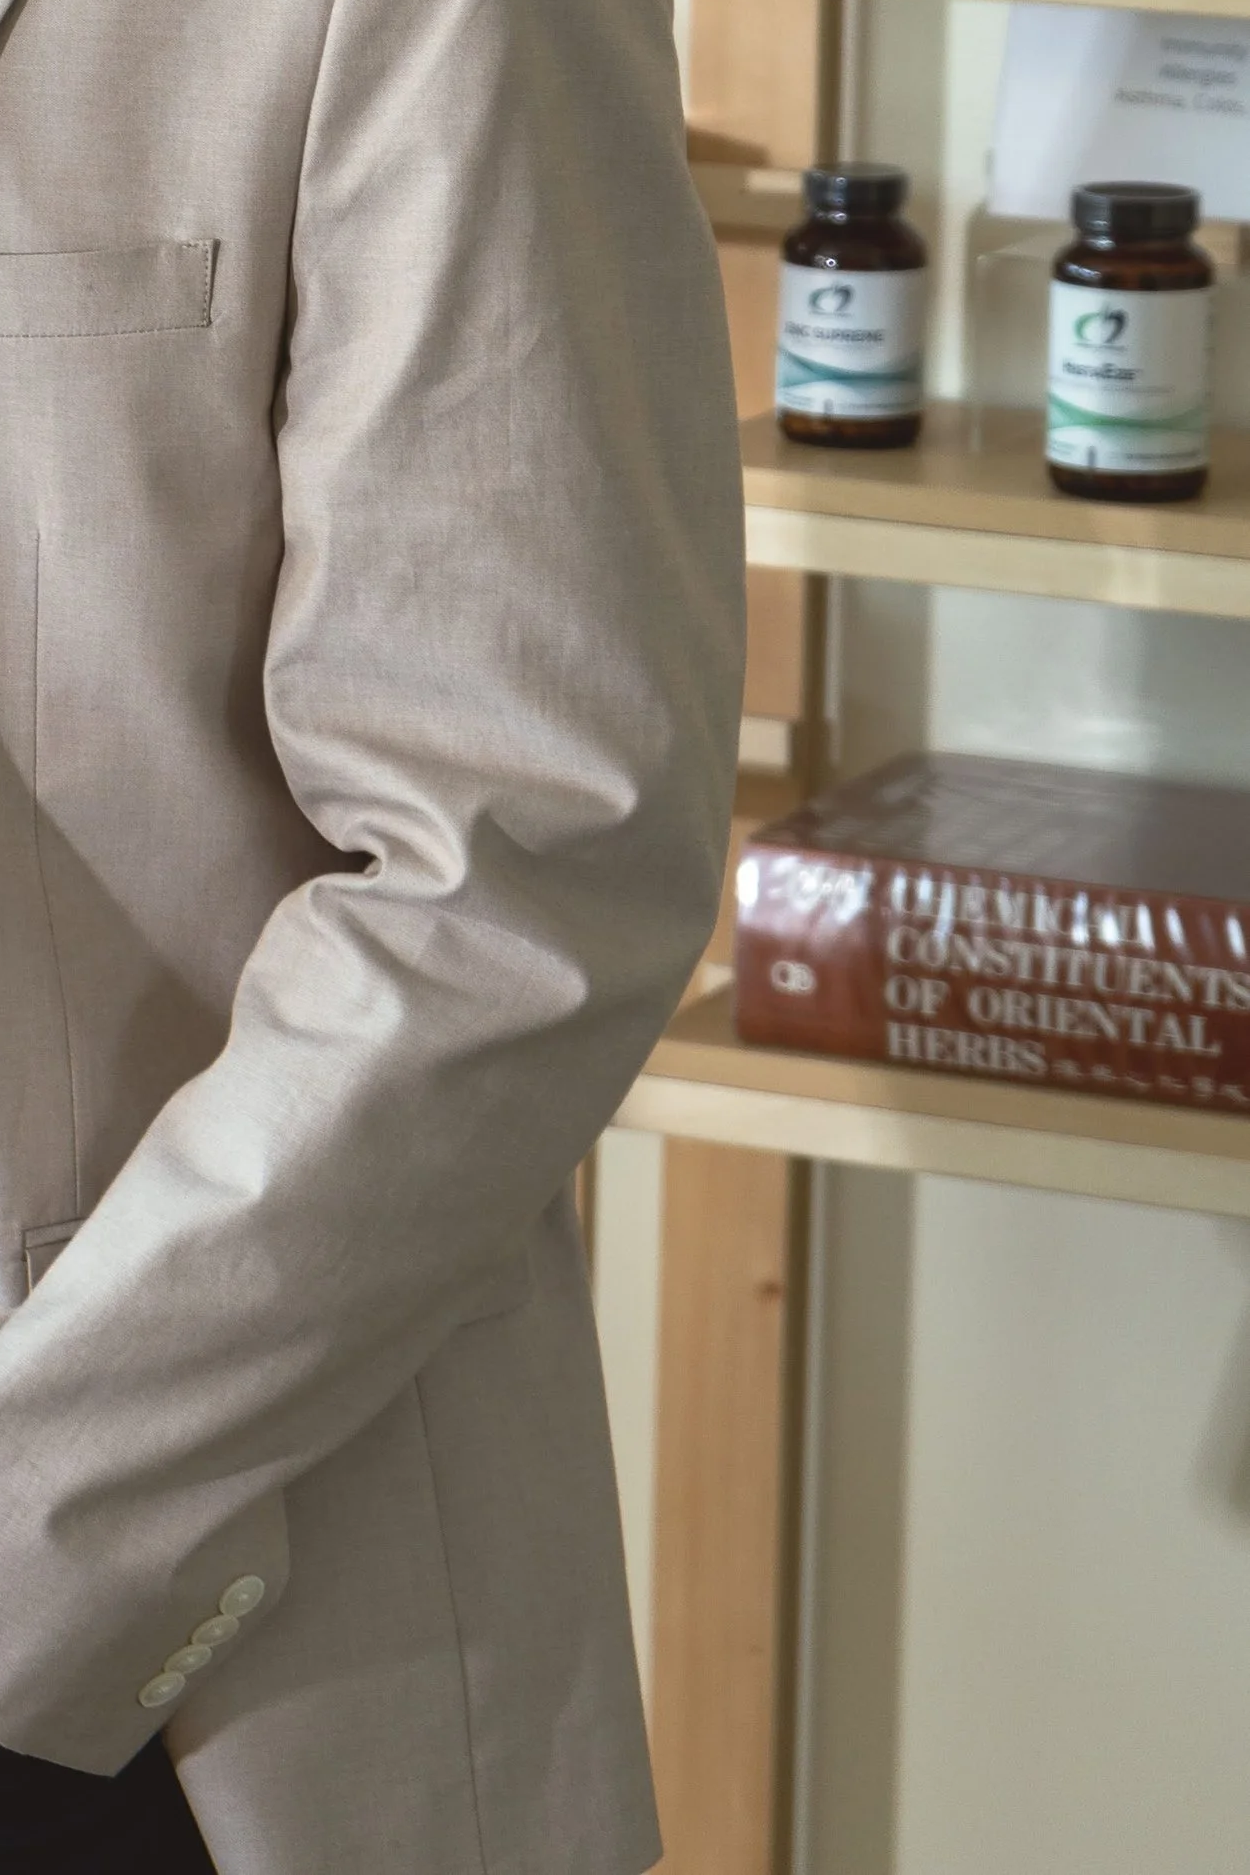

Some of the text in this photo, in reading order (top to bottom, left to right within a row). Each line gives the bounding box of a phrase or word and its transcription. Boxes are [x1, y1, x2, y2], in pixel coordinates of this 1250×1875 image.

[886, 926, 1250, 1010] CONSTITUENTS
[885, 974, 949, 1018] OF
[968, 985, 1222, 1056] ORIENTAL
[886, 1020, 1047, 1077] HERBS
